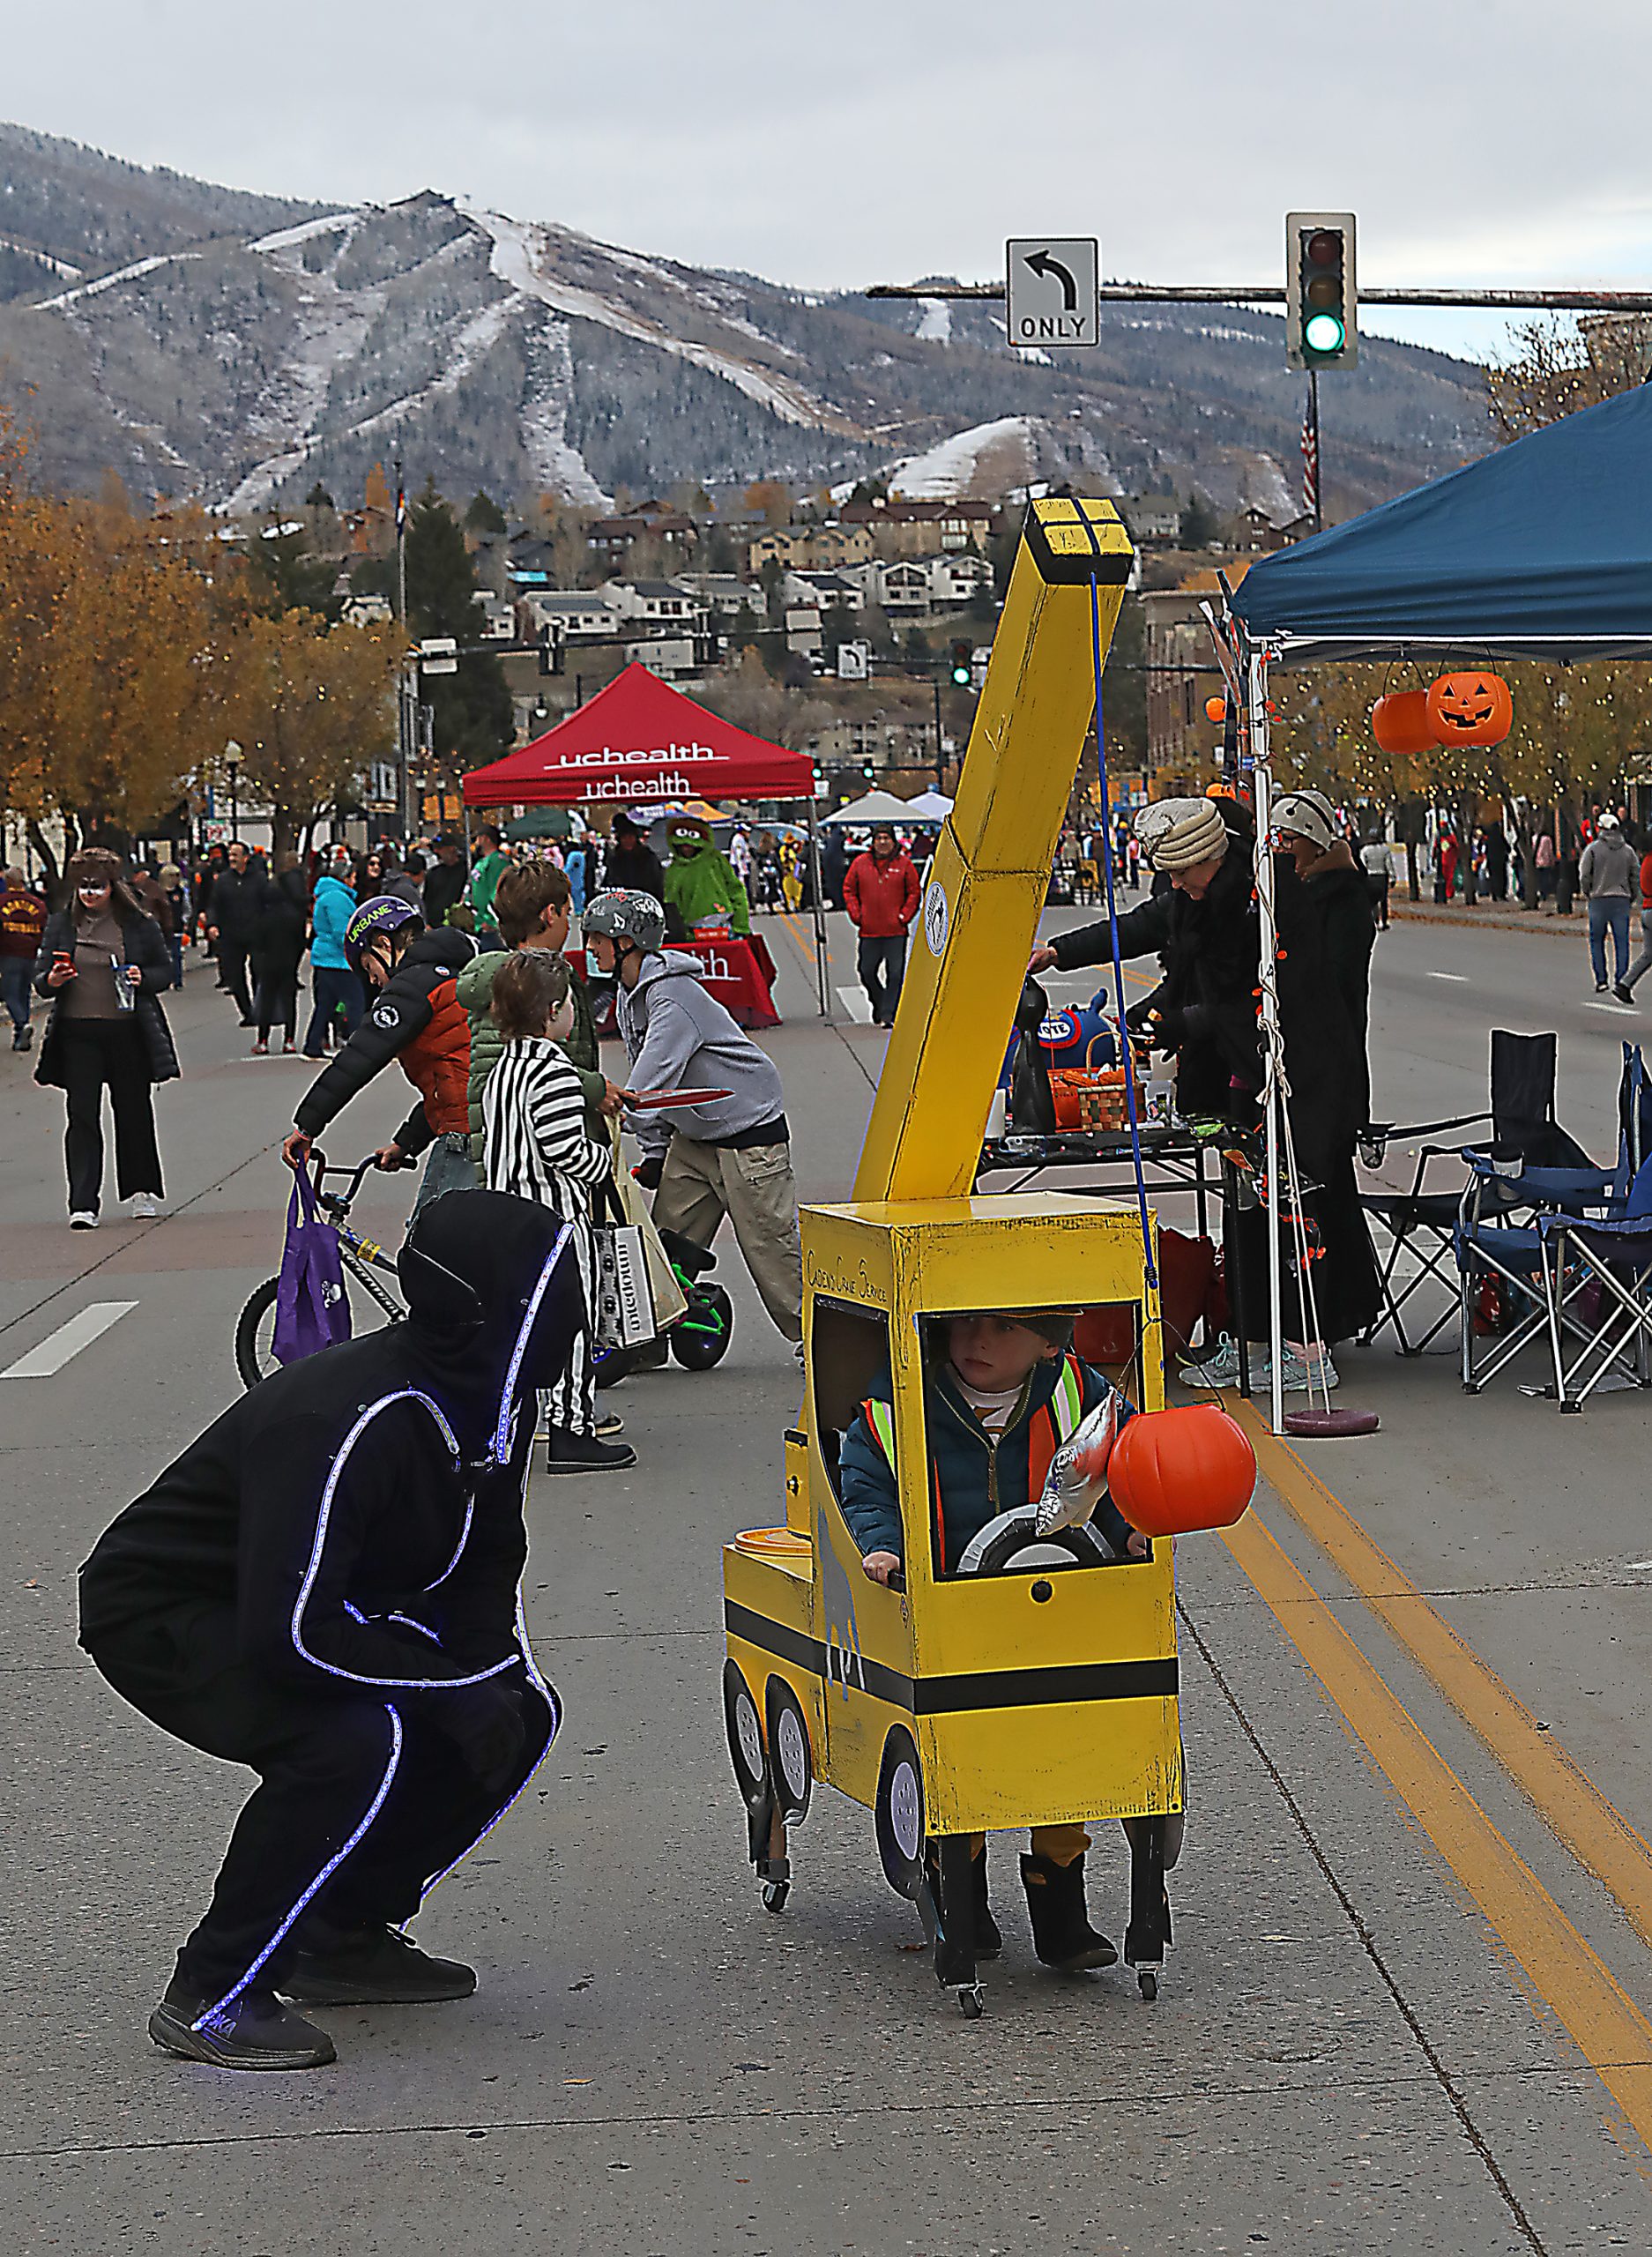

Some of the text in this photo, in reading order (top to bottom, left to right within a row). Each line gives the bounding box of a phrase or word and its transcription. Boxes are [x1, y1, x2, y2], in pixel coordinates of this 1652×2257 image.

[1021, 317, 1085, 338] ONLY
[560, 742, 713, 767] uchealth
[585, 771, 691, 797] uchealth
[347, 904, 393, 943] URBANE
